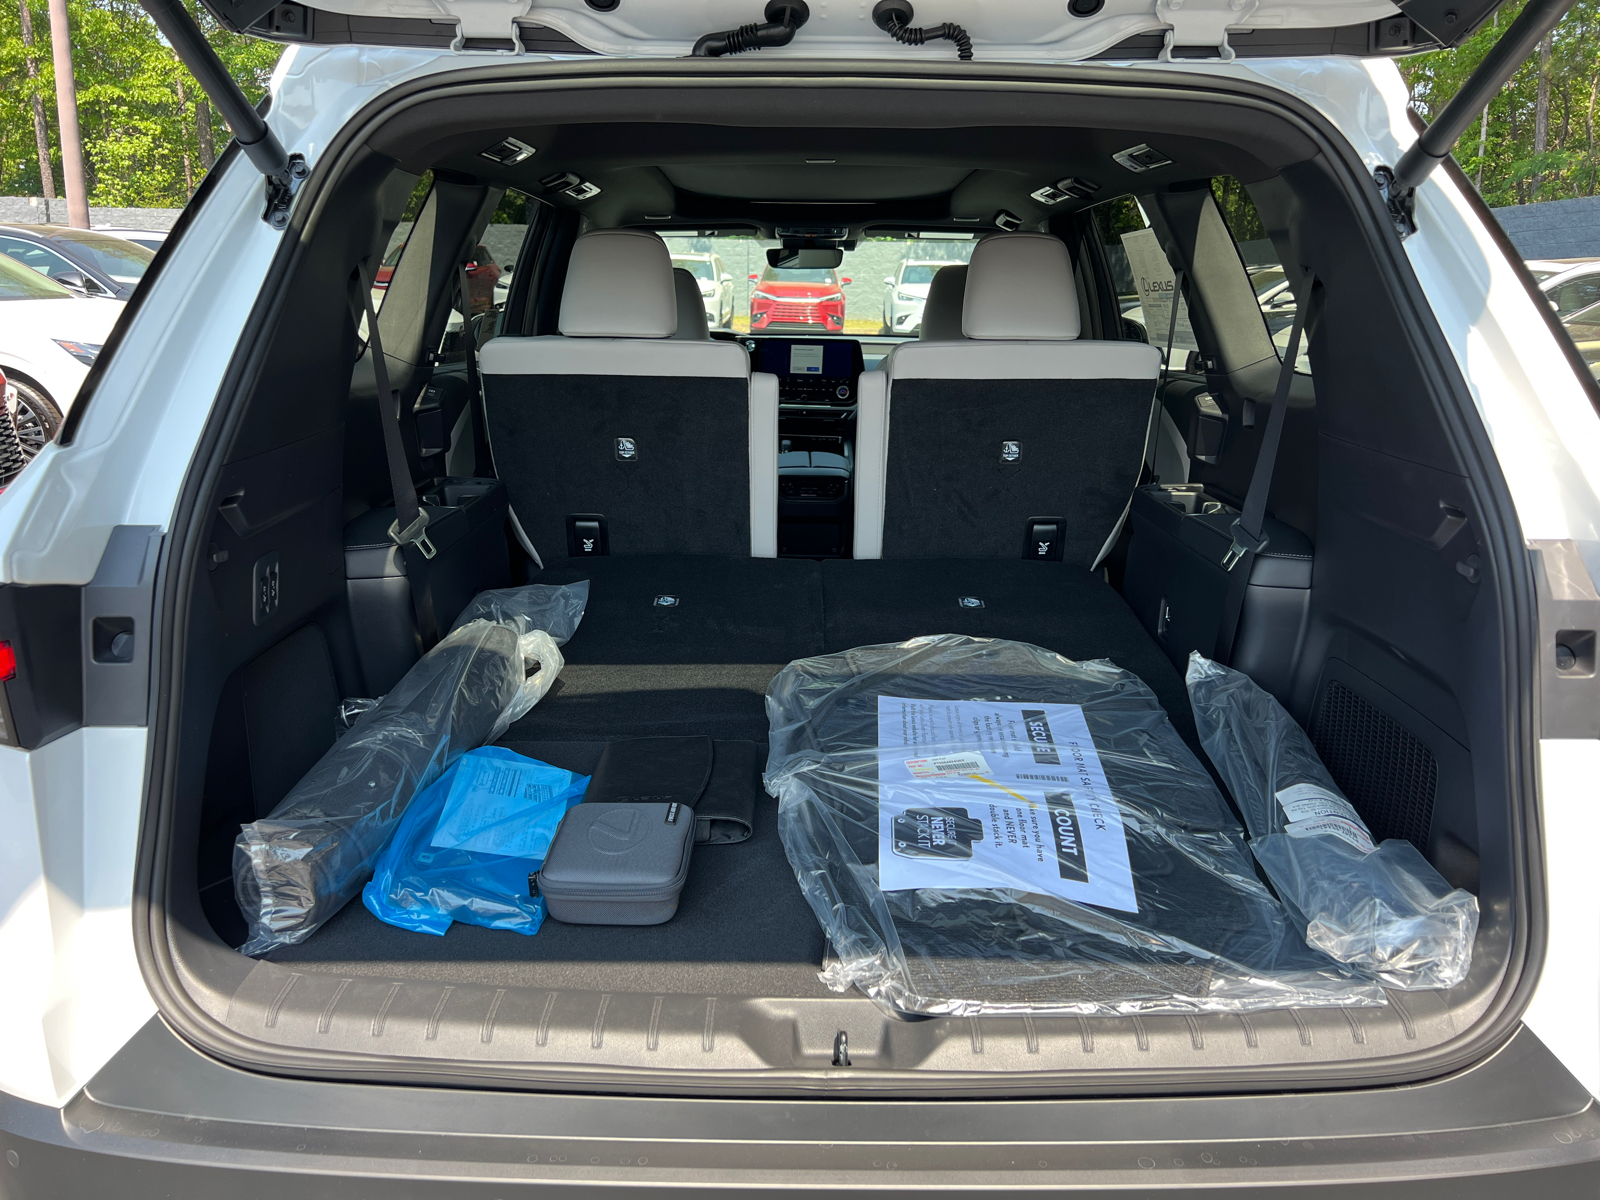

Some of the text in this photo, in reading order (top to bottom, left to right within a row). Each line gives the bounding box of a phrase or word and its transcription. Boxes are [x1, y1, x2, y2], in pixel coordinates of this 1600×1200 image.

[1149, 281, 1174, 292] LEXUS
[1029, 721, 1050, 752] SECUE
[1075, 762, 1088, 775] MAT
[1080, 777, 1097, 801] SAFTY
[989, 803, 999, 822] double
[1030, 816, 1039, 829] sure
[1088, 803, 1106, 830] CHECK
[931, 816, 945, 845] NEVER
[945, 816, 955, 838] SECURE
[992, 823, 1002, 840] stack
[1003, 808, 1017, 843] and NEVER
[1015, 807, 1029, 847] one floor mat
[1053, 808, 1078, 855] COUNT
[918, 839, 930, 847] IT
[1032, 830, 1041, 842] you
[1035, 844, 1047, 862] have
